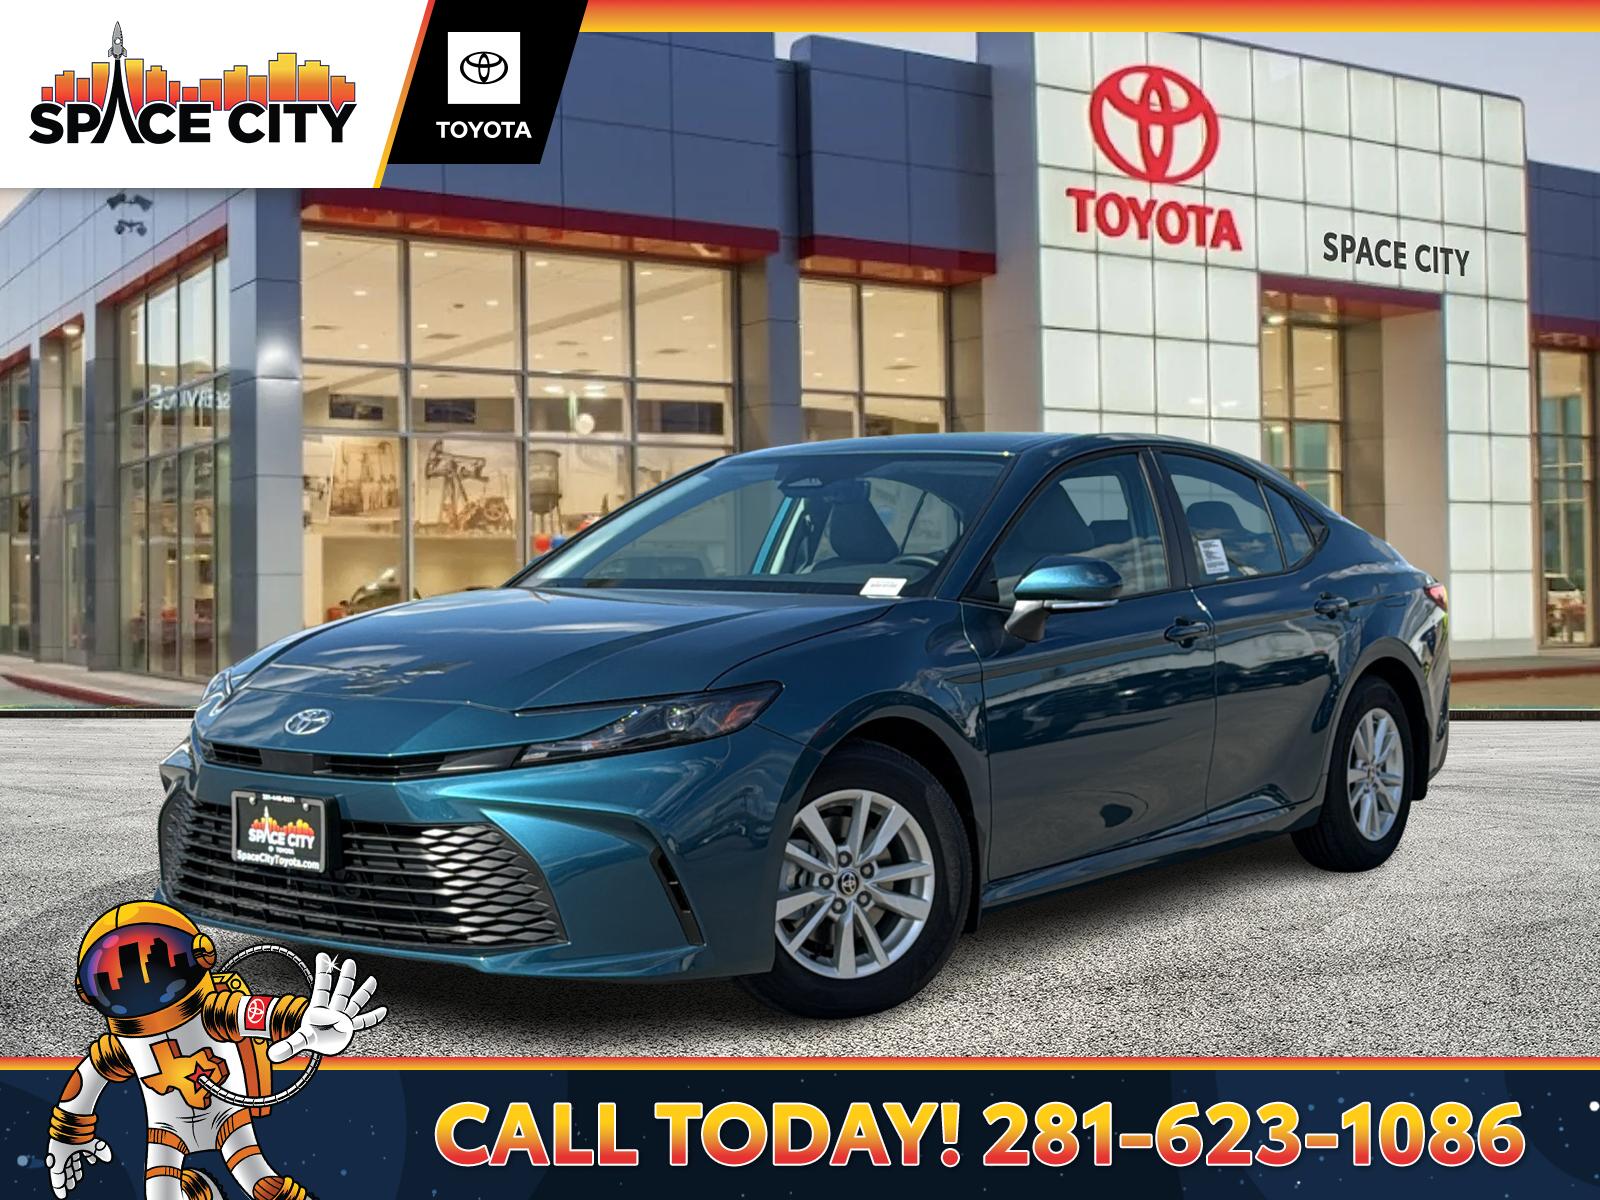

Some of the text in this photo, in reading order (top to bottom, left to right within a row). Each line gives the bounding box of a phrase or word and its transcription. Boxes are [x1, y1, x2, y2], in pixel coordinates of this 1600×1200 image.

[1065, 187, 1243, 252] TOYOTA
[1322, 231, 1470, 277] SPACE CITY
[248, 826, 316, 850] SPACE CITY
[237, 849, 320, 870] SpaceCityToyota.com
